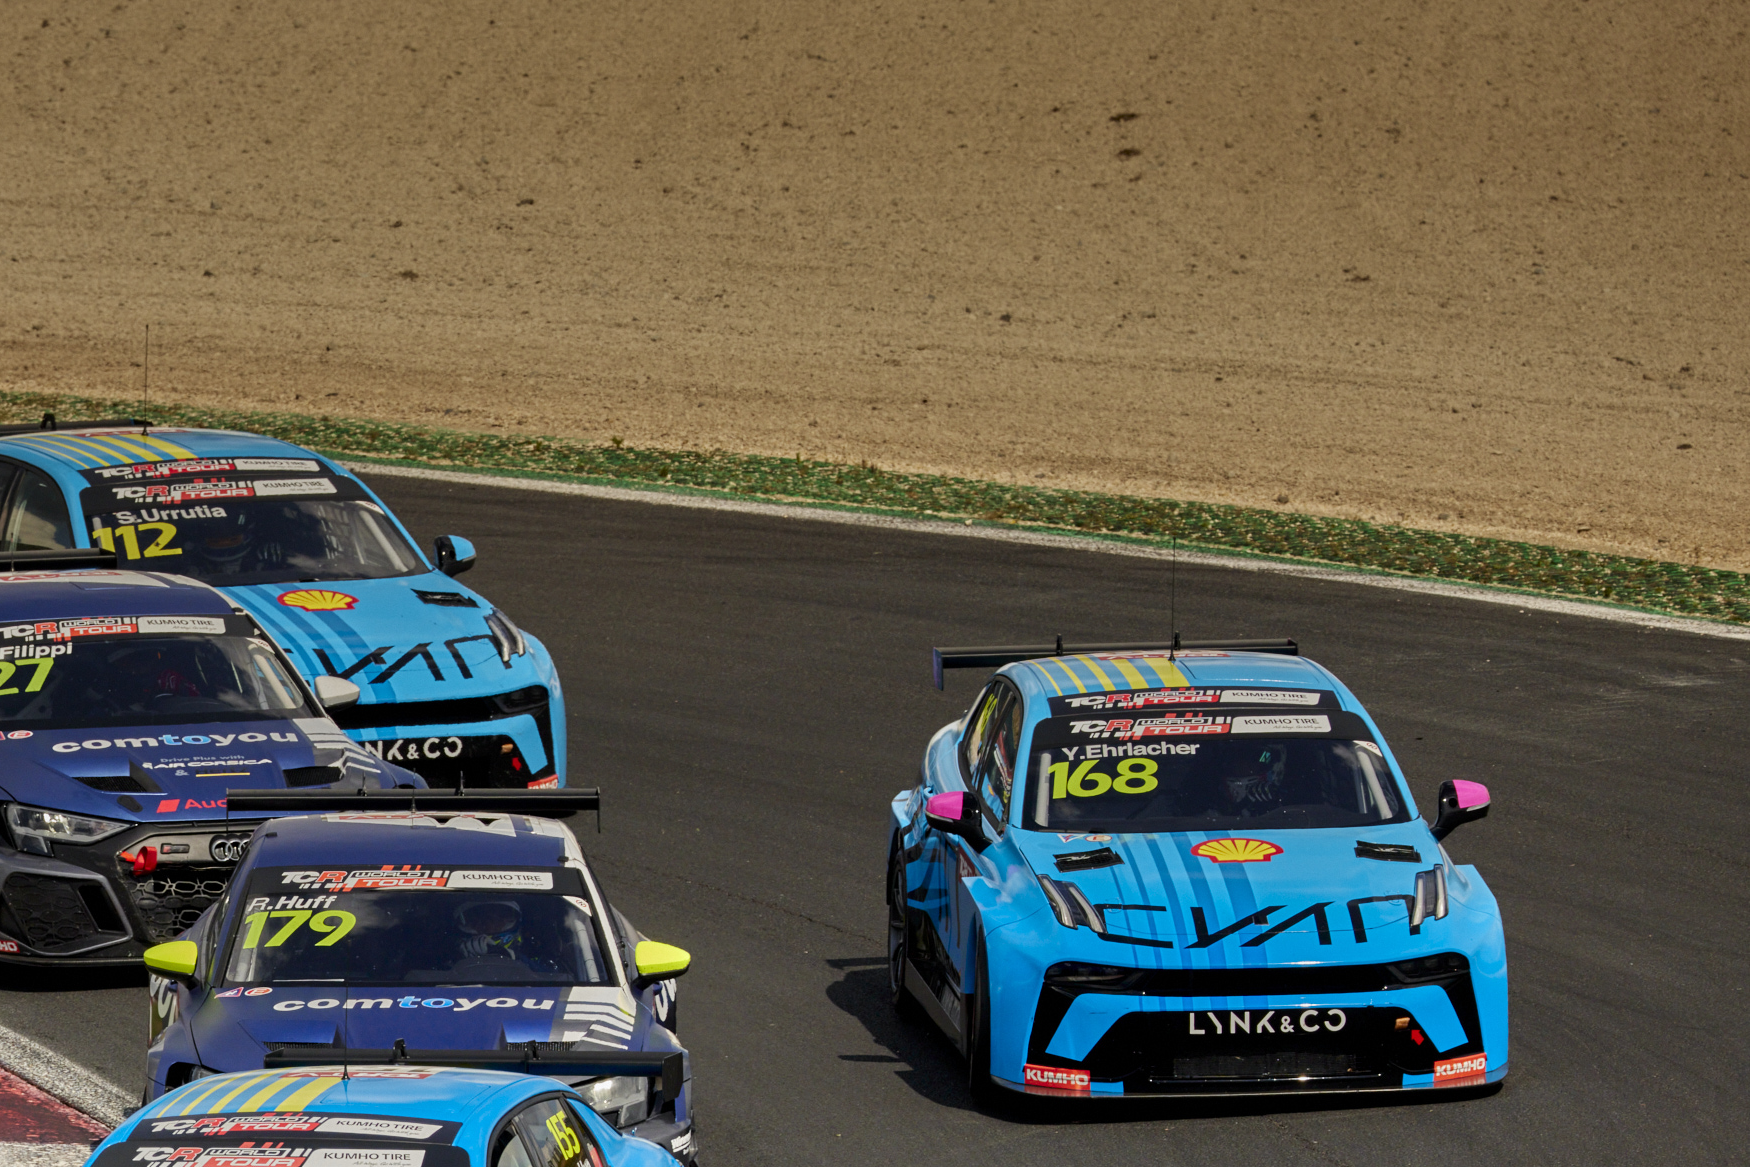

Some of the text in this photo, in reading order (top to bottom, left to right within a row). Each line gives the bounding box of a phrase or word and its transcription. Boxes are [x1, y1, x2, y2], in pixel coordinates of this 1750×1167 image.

[95, 464, 155, 478] TCR
[177, 463, 230, 473] TOUR
[112, 485, 169, 499] TCR
[263, 481, 302, 489] KUMHO
[185, 489, 249, 499] TOUR
[115, 504, 228, 525] S.Urrutia
[92, 521, 183, 560] 112
[74, 625, 133, 635] TOUR
[1065, 693, 1132, 707] TCR
[1149, 696, 1213, 704] TOUR
[1070, 720, 1134, 734] TCR
[1150, 725, 1223, 735] TOUR
[53, 731, 299, 753] comtoyou
[365, 736, 463, 761] NK&CO
[1062, 741, 1200, 761] Y.Ehrlacher
[188, 758, 272, 767] CORSICA
[1047, 757, 1159, 799] 168
[281, 870, 348, 883] TCR
[363, 878, 439, 887] TOUR
[249, 895, 338, 912] R.Huff
[242, 910, 357, 950] 179
[273, 994, 554, 1014] comtoyou
[1436, 1057, 1486, 1078] KUMHO
[1026, 1068, 1089, 1086] KUMHO
[151, 1117, 226, 1132] TCR
[240, 1122, 311, 1131] TOUR
[337, 1120, 390, 1129] KUMHO
[393, 1123, 424, 1132] TIRE
[545, 1110, 581, 1161] 155
[132, 1146, 282, 1162] TCR WORLD
[324, 1152, 411, 1161] KUMHO TIRE
[215, 1157, 296, 1167] TOUR
